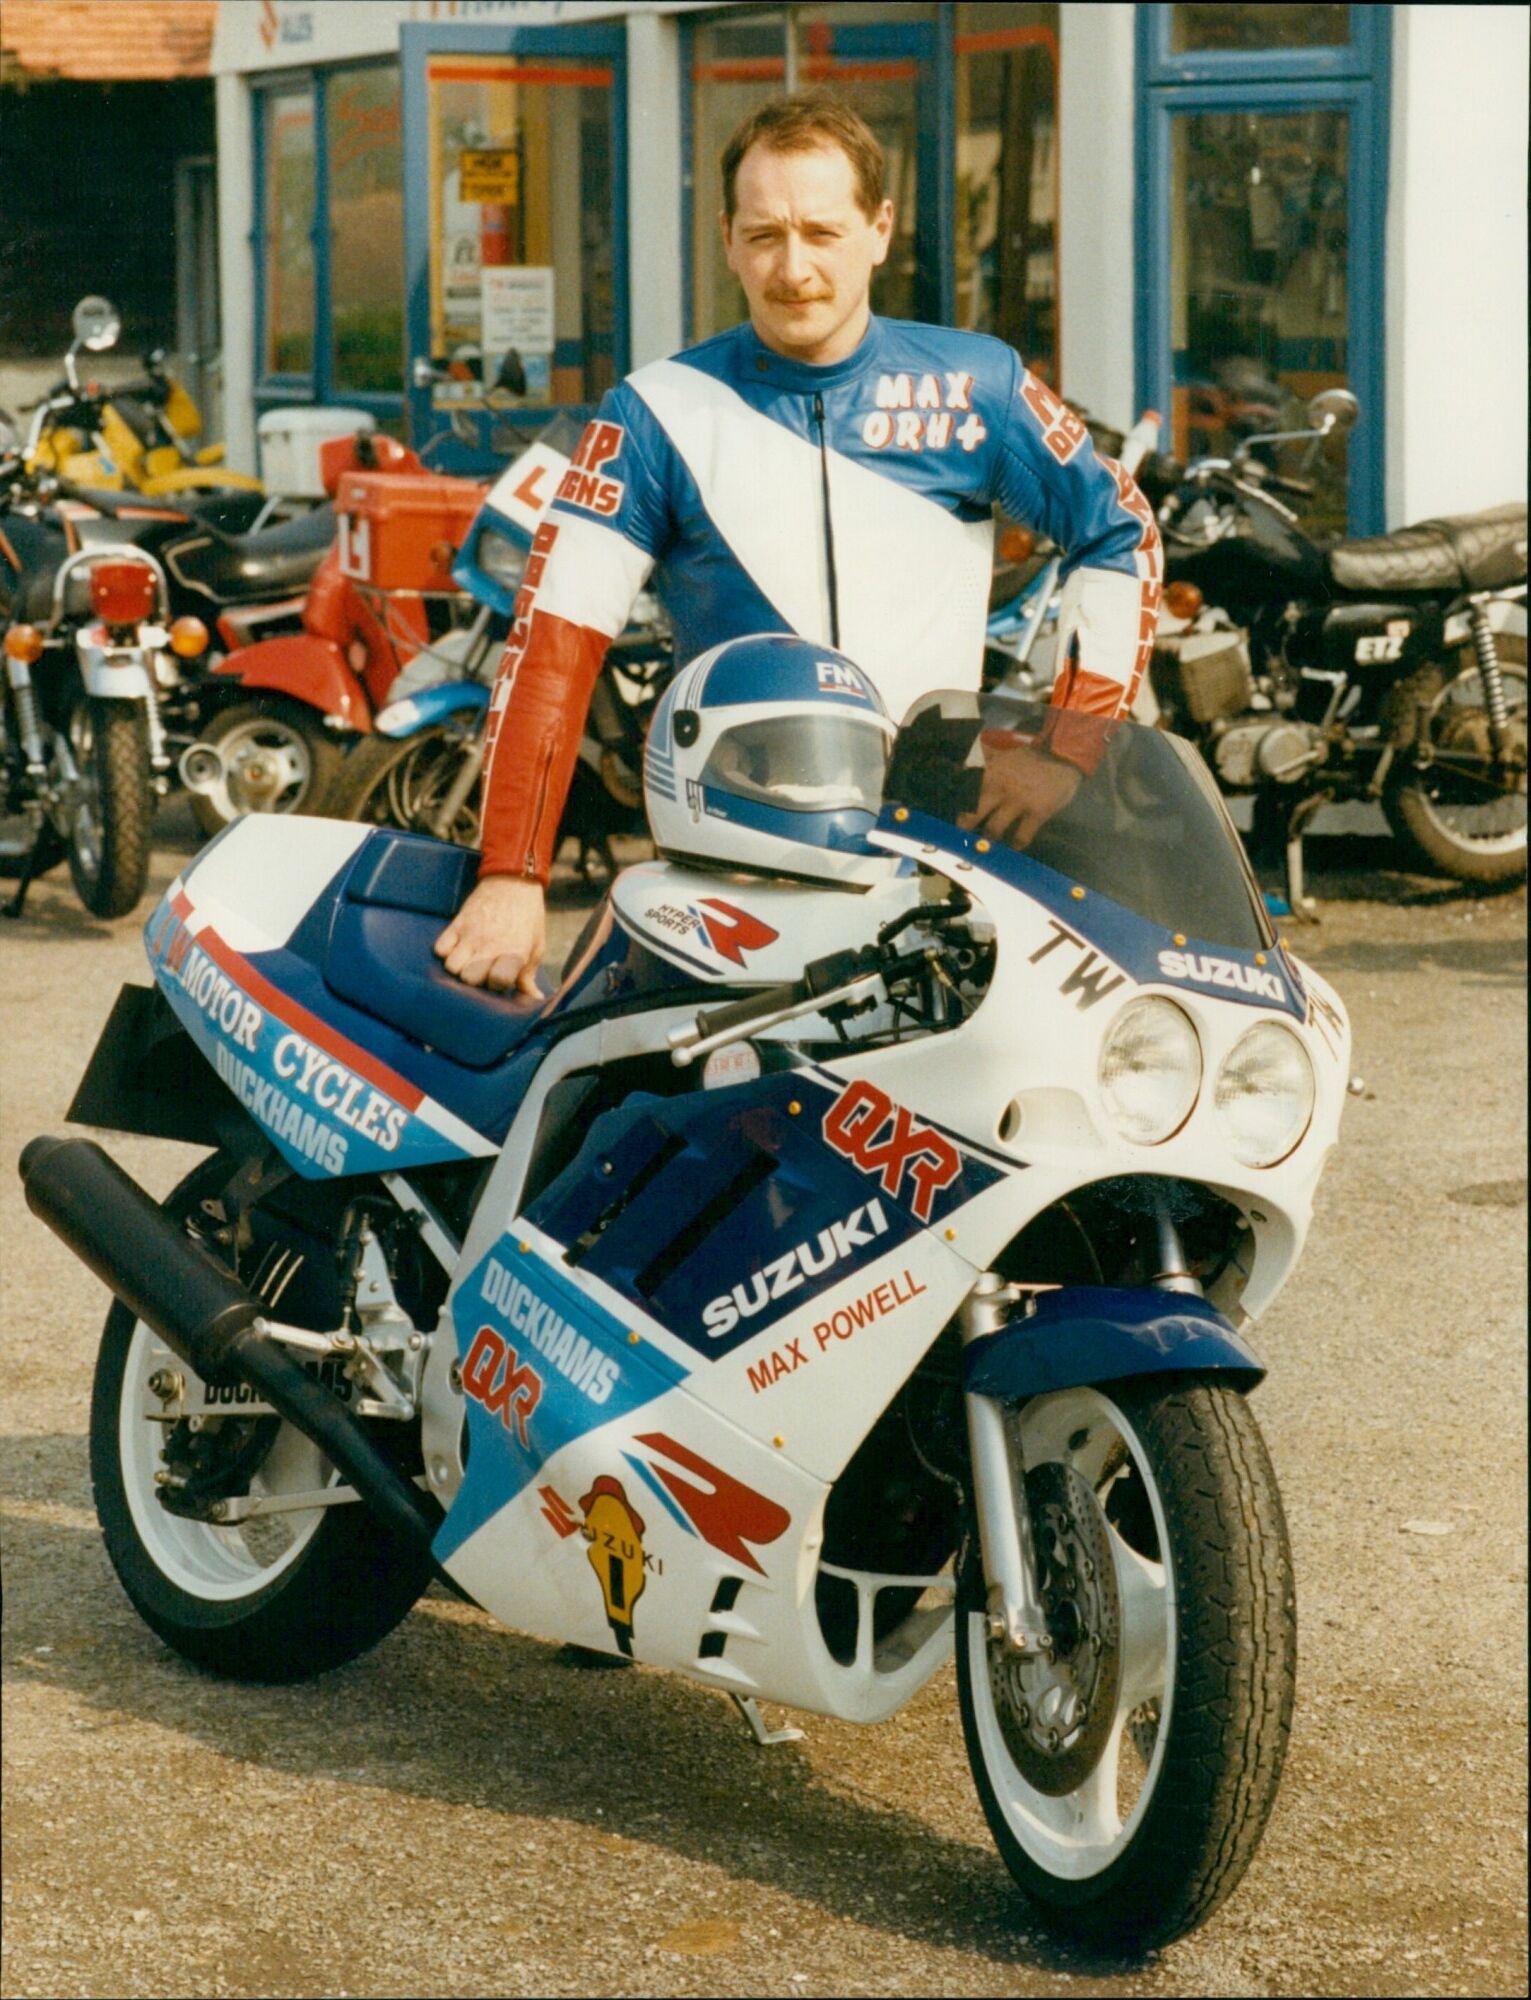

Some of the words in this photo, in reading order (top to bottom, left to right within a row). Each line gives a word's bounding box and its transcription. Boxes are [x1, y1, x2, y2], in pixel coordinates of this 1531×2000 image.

[876, 371, 974, 411] MAX
[512, 465, 548, 510] L
[815, 661, 865, 691] FM
[1354, 636, 1404, 664] ETZ
[643, 908, 690, 935] SPORTS
[659, 903, 701, 929] HYPER
[1028, 918, 1128, 1012] TW
[1157, 949, 1286, 1003] SUZUKI
[180, 945, 263, 1053] MOTOR
[272, 1033, 409, 1152] CYCLES
[214, 1040, 349, 1176] DUCKHAMS
[821, 1079, 963, 1225] QXR
[701, 1197, 890, 1339] SUZUKI
[479, 1257, 621, 1405] DUCKHAMS
[745, 1337, 809, 1394] MAX
[812, 1269, 928, 1352] POWELL
[459, 1323, 543, 1451] QXR
